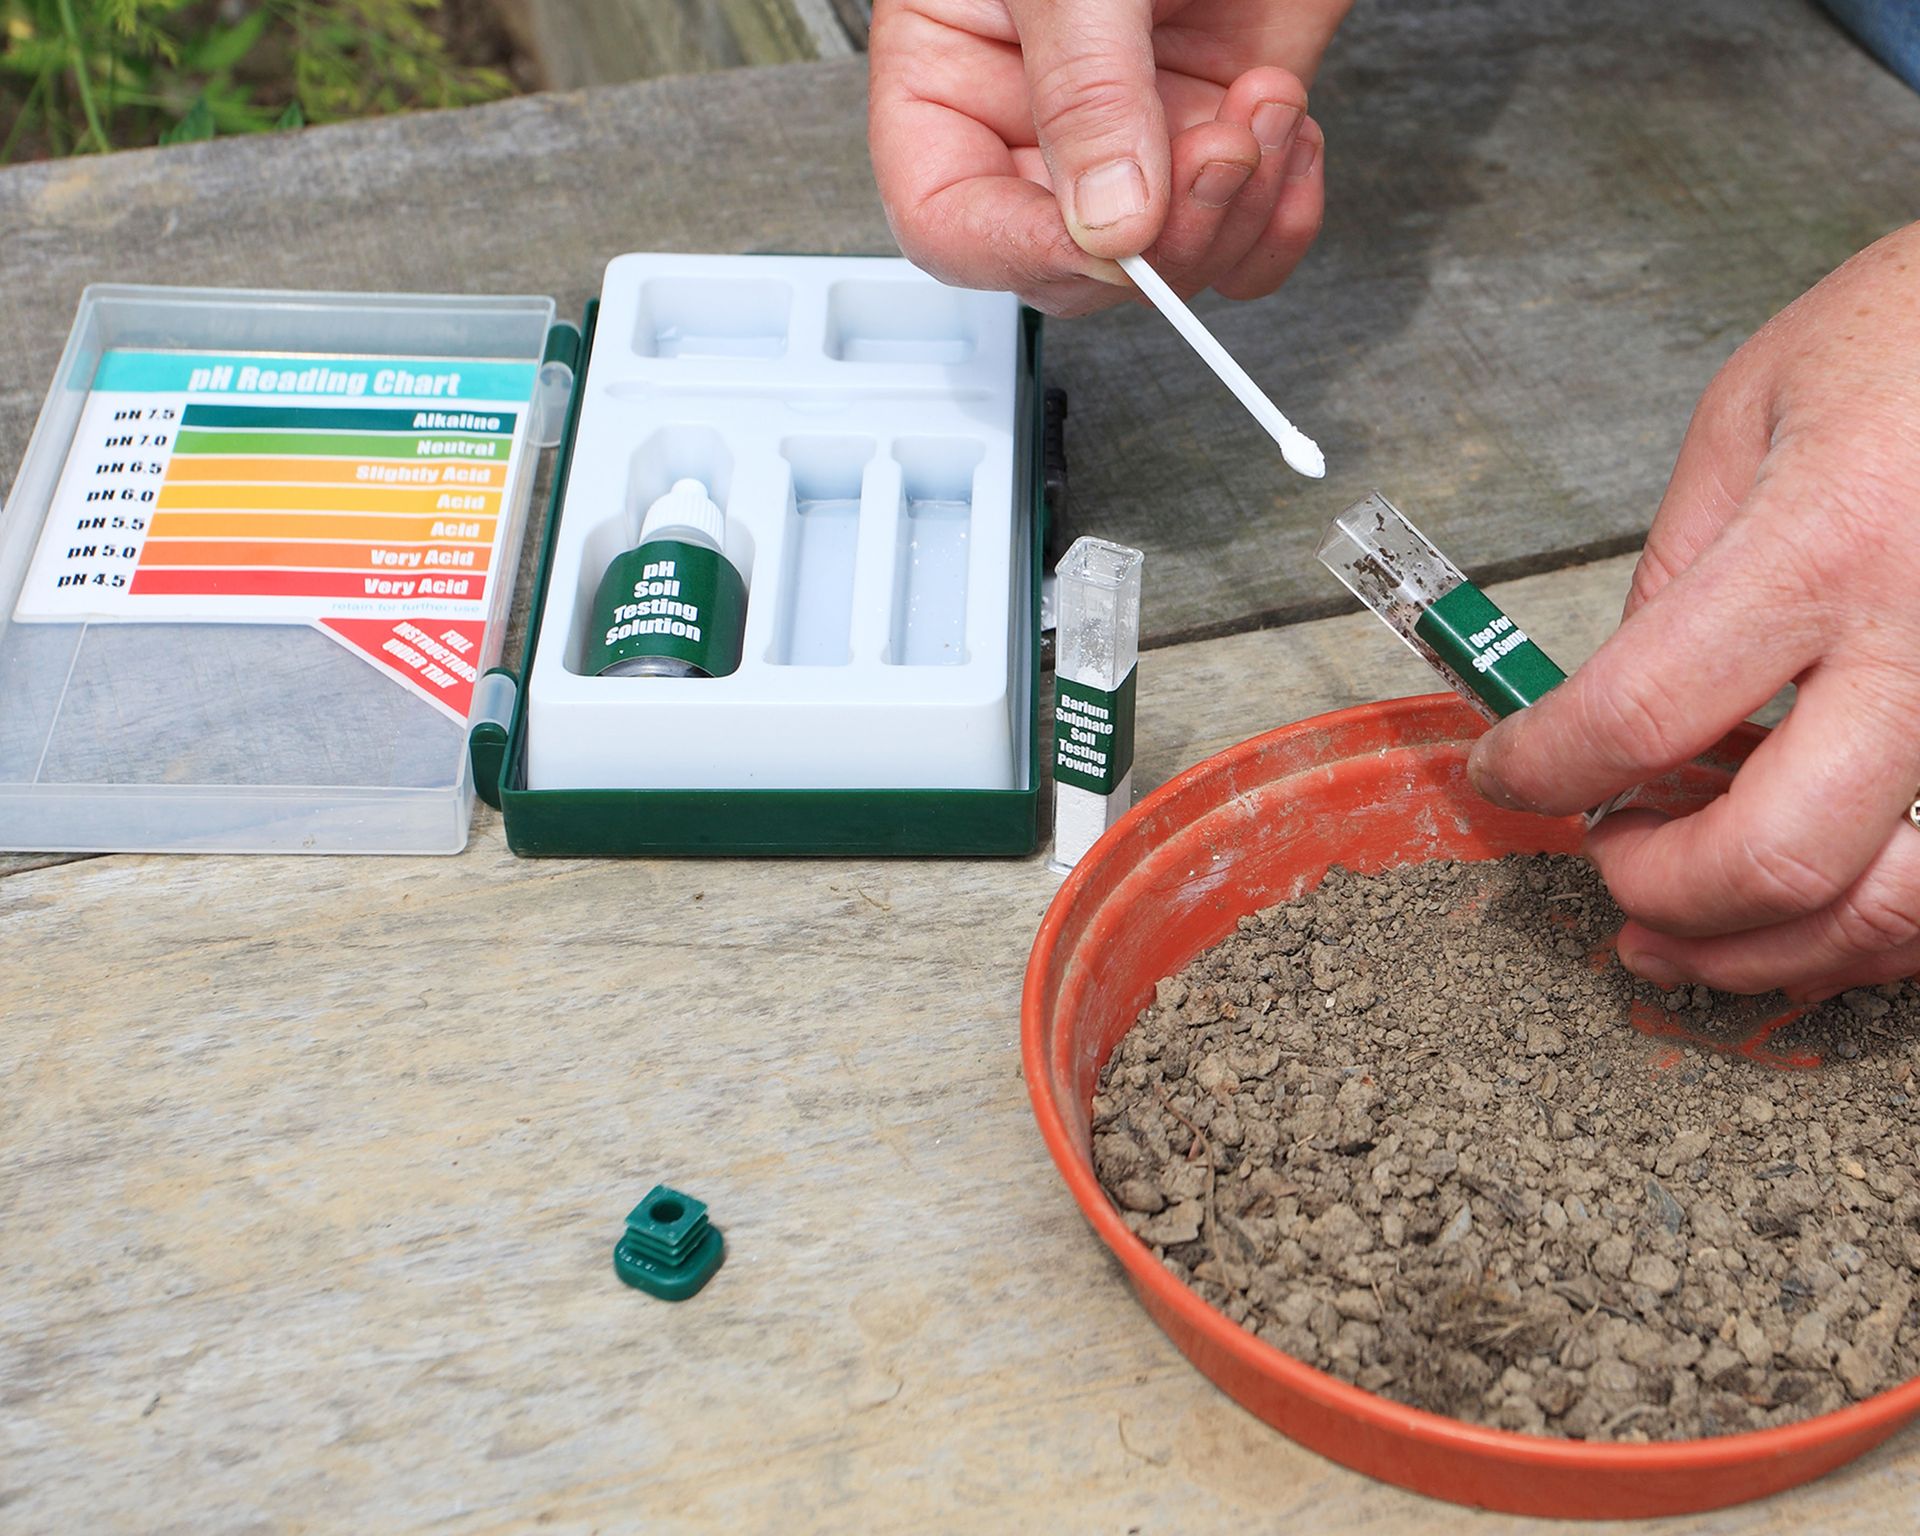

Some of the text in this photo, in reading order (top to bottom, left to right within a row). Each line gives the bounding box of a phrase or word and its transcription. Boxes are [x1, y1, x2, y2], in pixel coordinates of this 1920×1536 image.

[188, 365, 461, 396] pH Reading Chart
[148, 409, 175, 421] 7.5
[412, 412, 500, 431] Alkaline
[140, 435, 167, 446] 7.0
[416, 439, 496, 456] Neutral
[130, 461, 162, 474] 6.5
[355, 465, 491, 483] Slightly Acid
[121, 488, 154, 502] 6.0
[436, 494, 485, 511] Acid
[111, 516, 145, 531] 5.5
[430, 521, 480, 538] Acid
[102, 544, 136, 559] 5.0
[370, 549, 474, 567] Very Acid
[642, 560, 676, 580] pH
[92, 573, 126, 588] 4.5
[364, 578, 469, 596] Very Acid
[634, 579, 681, 598] Soil
[331, 602, 480, 613] retain for further use
[614, 598, 698, 624] Testing
[605, 617, 702, 646] Solution
[1468, 615, 1513, 648] Use For
[439, 629, 474, 654] FULL
[392, 621, 477, 683] INSTRUCTIONS
[1472, 646, 1500, 673] Soil
[382, 638, 458, 689] UNDER TRAY
[1061, 694, 1109, 720] Barium
[1055, 707, 1113, 735] Sulphate
[1070, 727, 1096, 746] Soil
[1058, 738, 1107, 765] Testing
[1057, 753, 1107, 779] Powder
